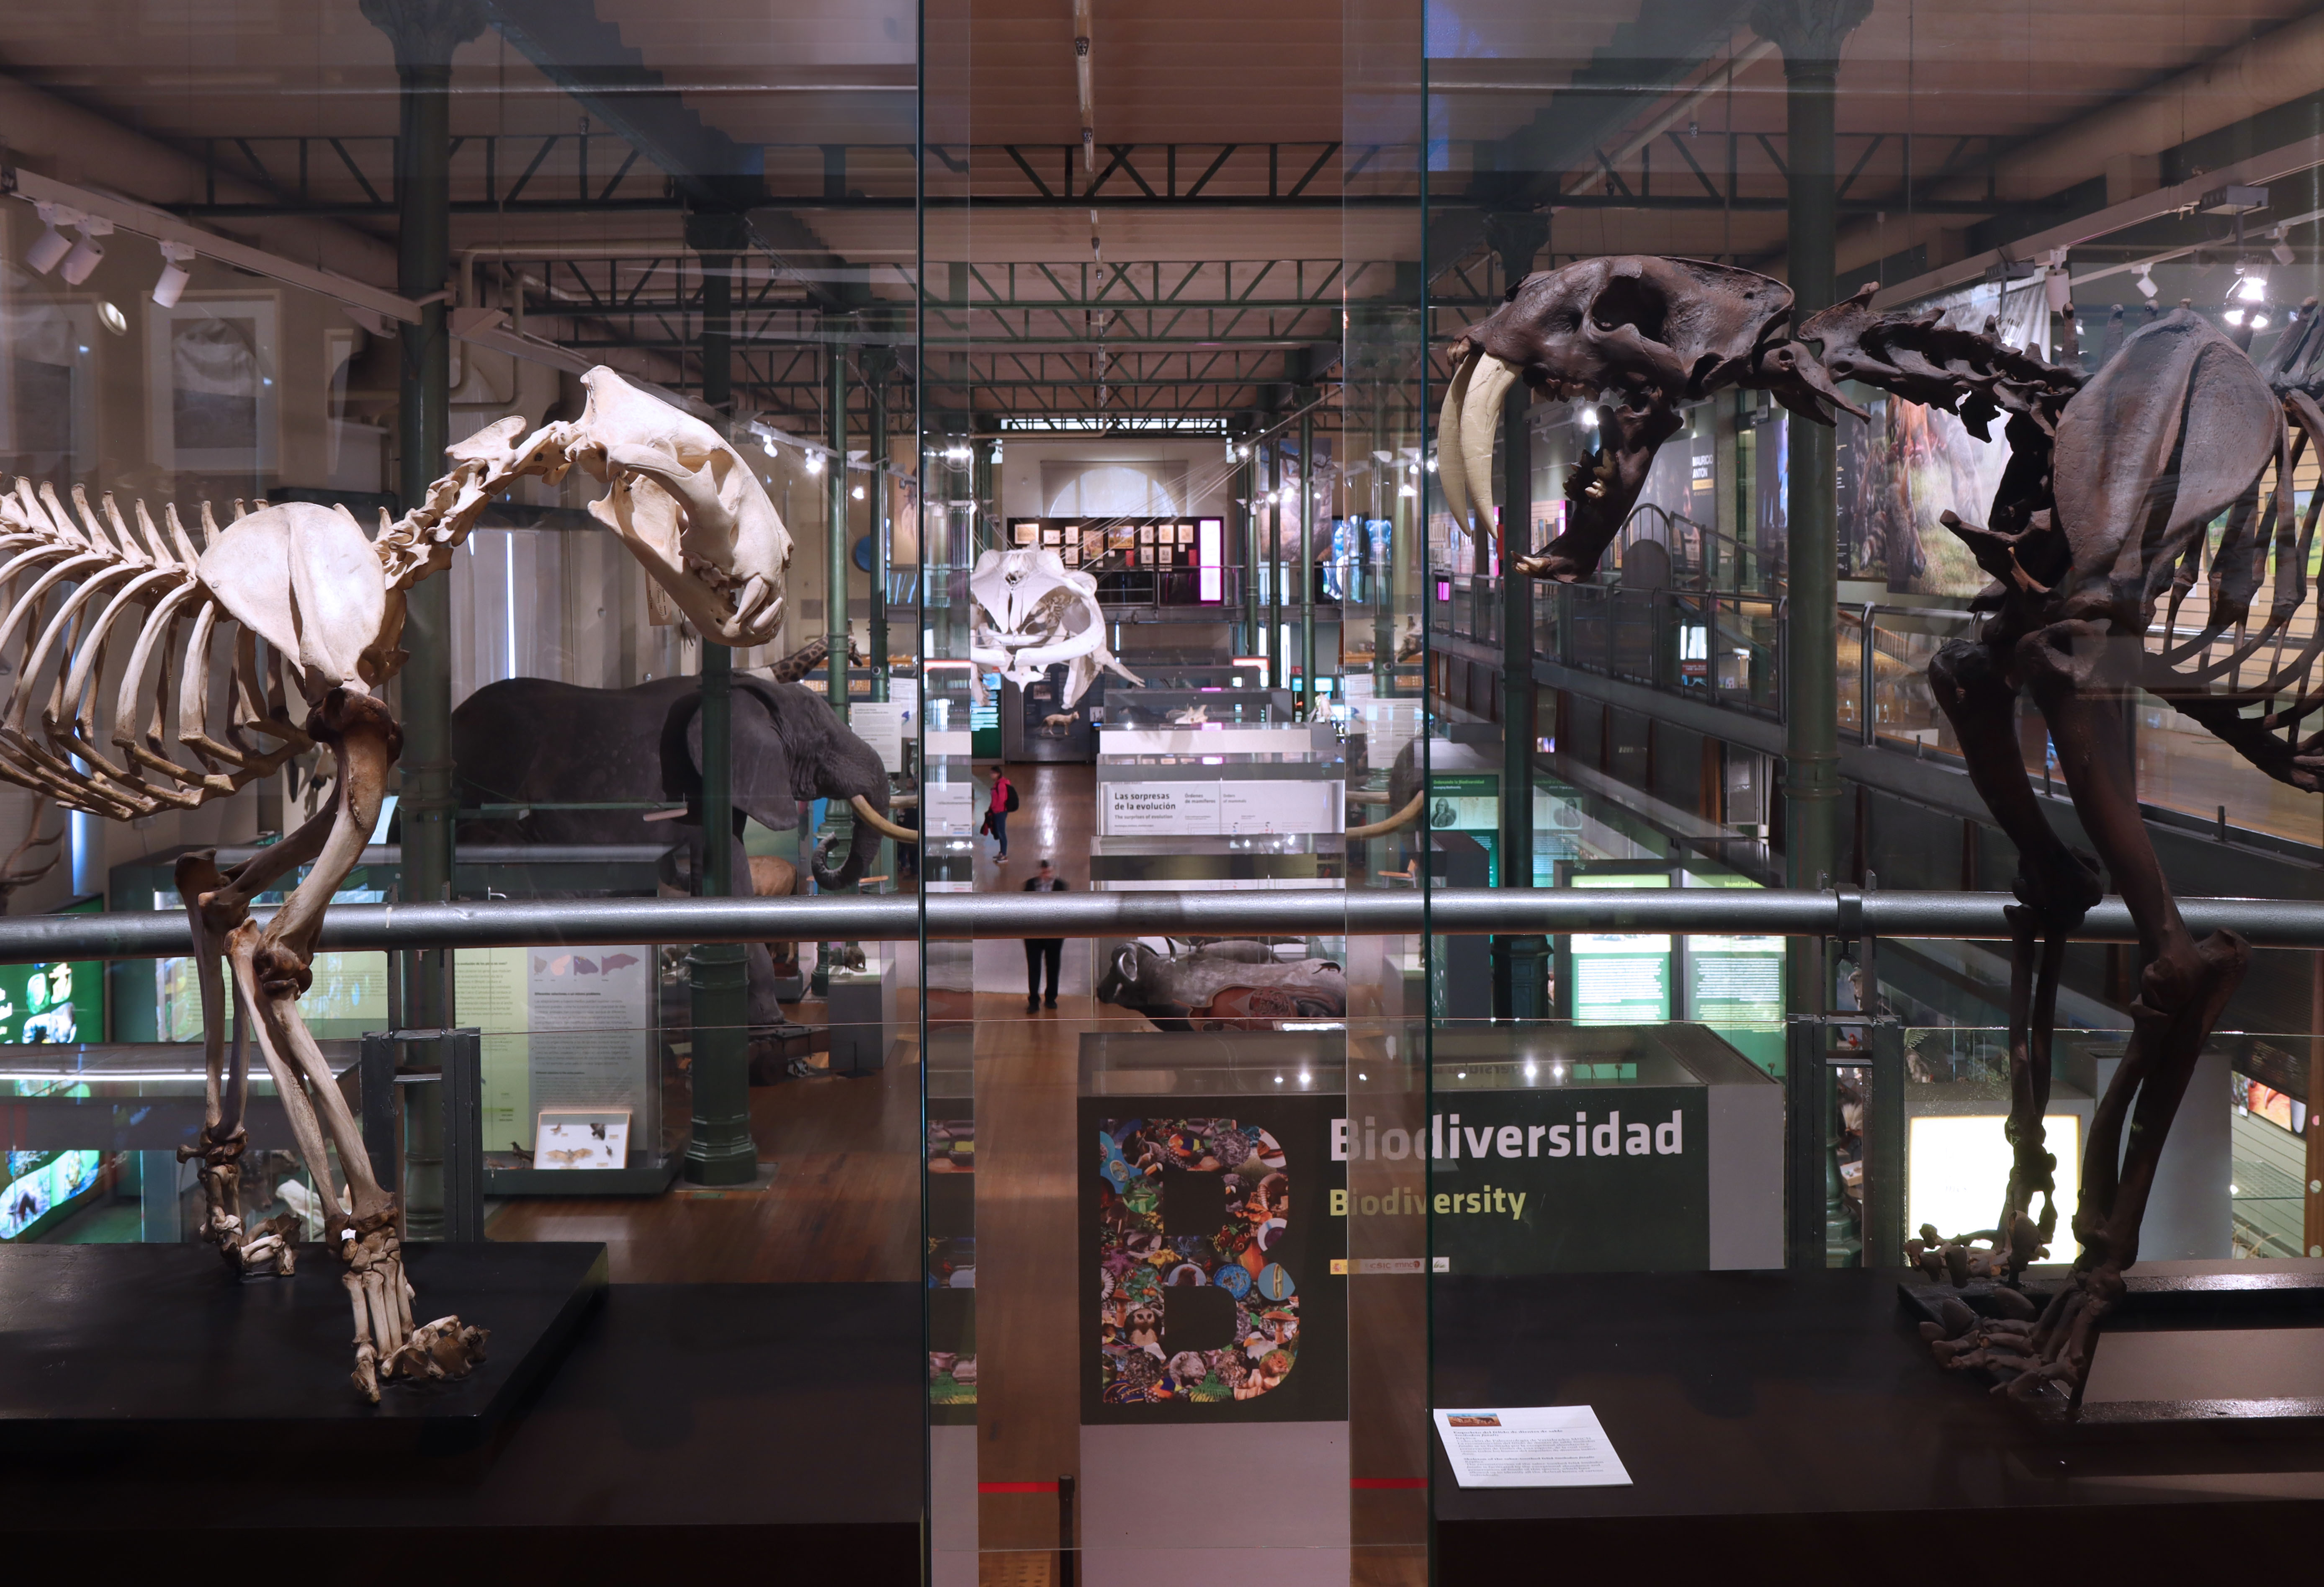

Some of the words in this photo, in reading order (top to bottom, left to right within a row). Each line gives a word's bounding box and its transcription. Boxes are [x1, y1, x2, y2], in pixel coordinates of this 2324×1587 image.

[1130, 793, 1170, 801] sorpresas
[1136, 801, 1176, 810] evolución
[1331, 1109, 1683, 1162] Biodiversidad
[1329, 1185, 1526, 1221] Biodiversity
